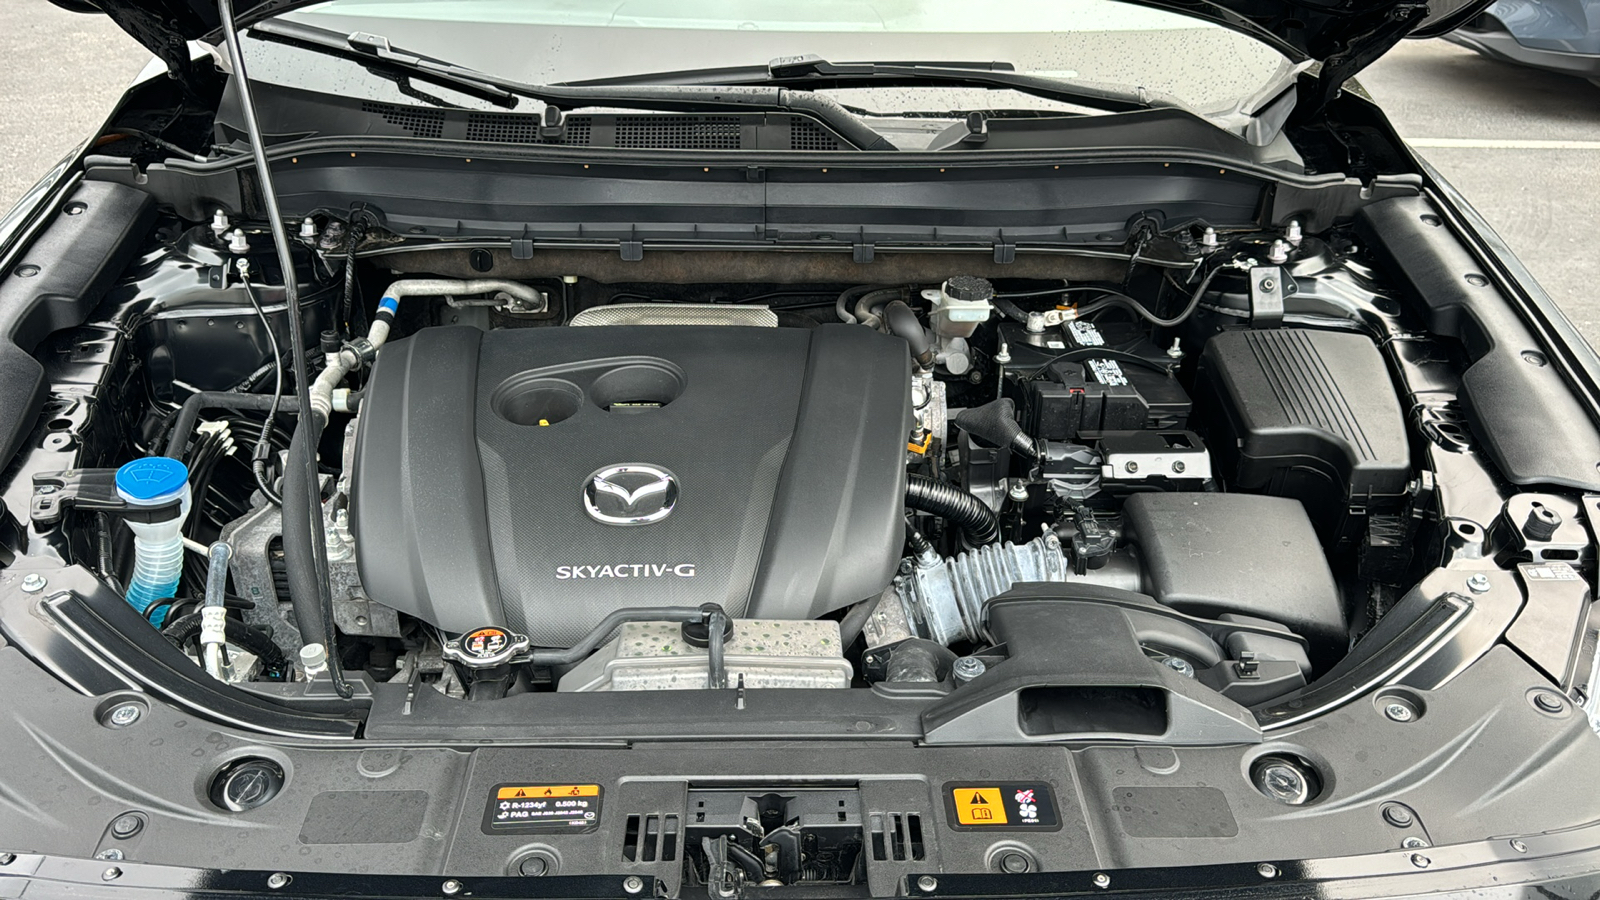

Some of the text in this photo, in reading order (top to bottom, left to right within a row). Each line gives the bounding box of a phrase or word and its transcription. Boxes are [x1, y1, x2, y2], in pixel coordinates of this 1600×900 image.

[555, 563, 696, 580] SKYACTIV-G
[511, 801, 547, 809] R-1234yf
[577, 800, 588, 808] kg
